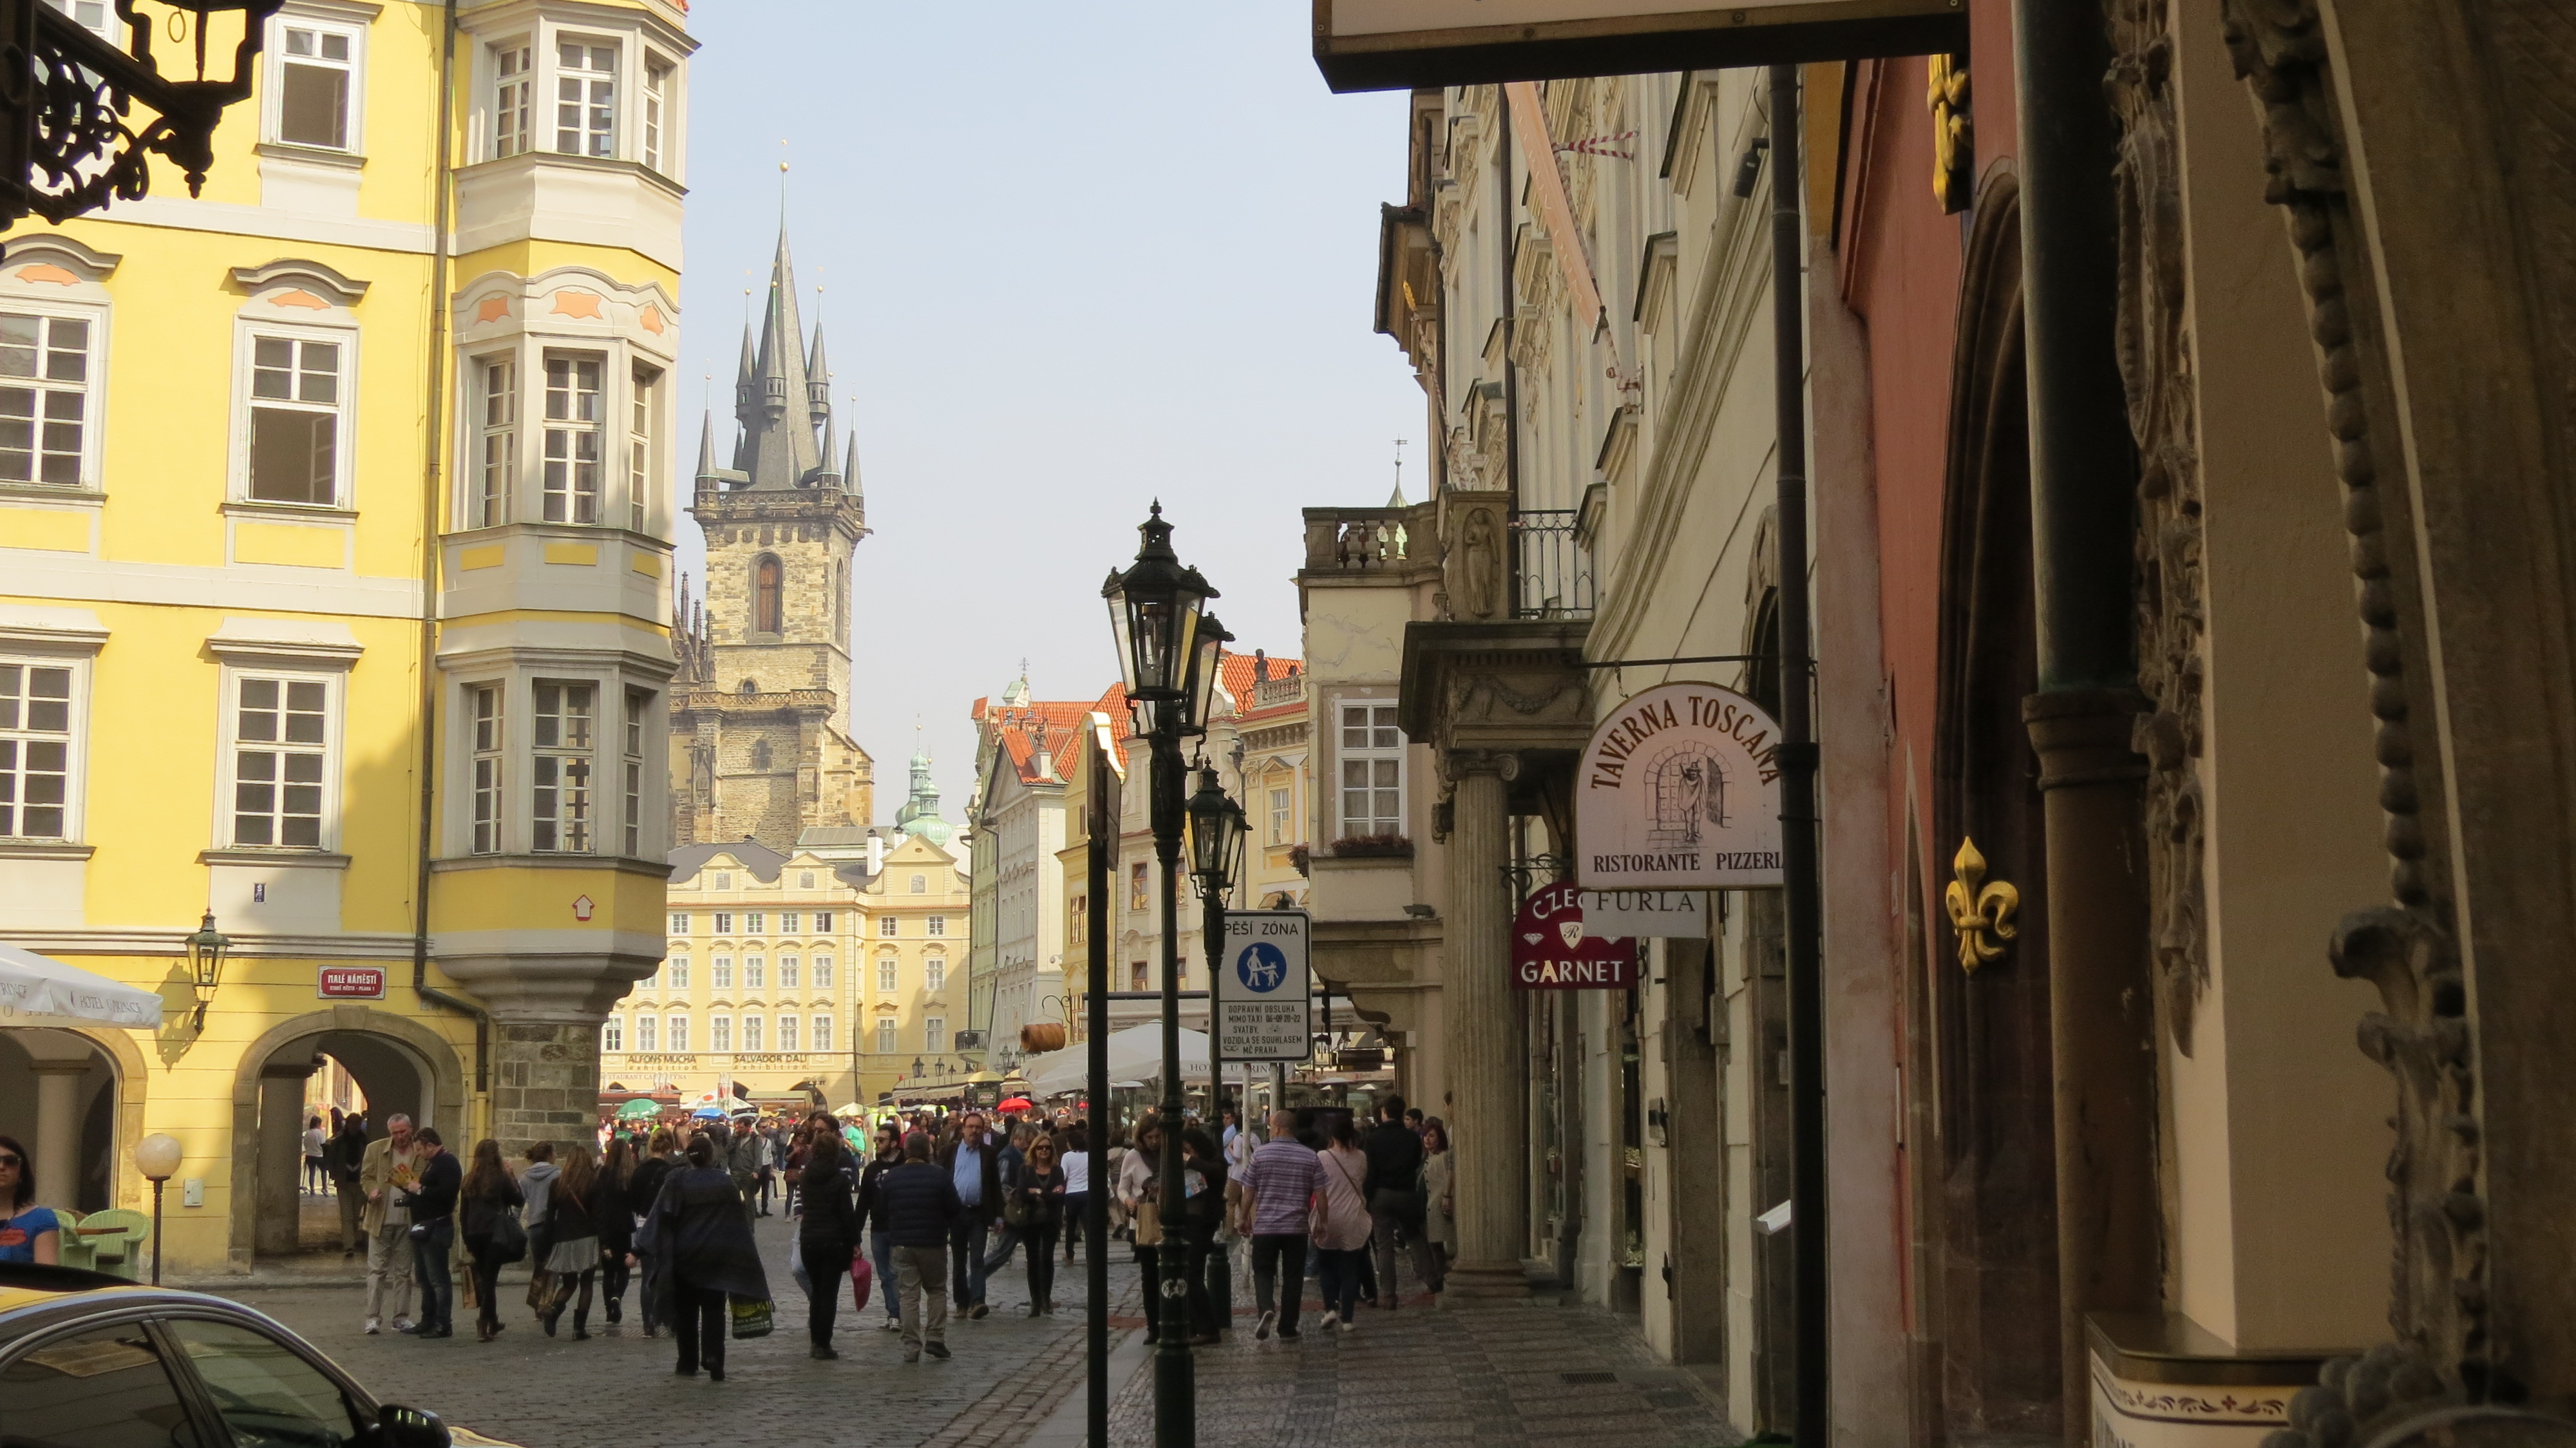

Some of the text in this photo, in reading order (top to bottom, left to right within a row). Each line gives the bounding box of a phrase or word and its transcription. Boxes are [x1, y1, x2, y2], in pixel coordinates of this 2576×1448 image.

[1591, 699, 1679, 789] TAVERNA
[1593, 852, 1783, 872] RISTORANTE PIZZERI
[1533, 889, 1583, 919] CZE
[1596, 891, 1695, 911] FURLA
[1224, 920, 1298, 935] PĚŠÍ ZÓNA
[328, 973, 377, 984] MALÉ NÁMĚSTÍ
[1521, 960, 1624, 982] GARNET
[80, 996, 104, 1009] HOTEL
[1228, 1004, 1295, 1013] DOPRAVNÍ OBSLUHA
[1224, 1036, 1251, 1044] VOZIDLA
[1252, 1036, 1260, 1044] SE
